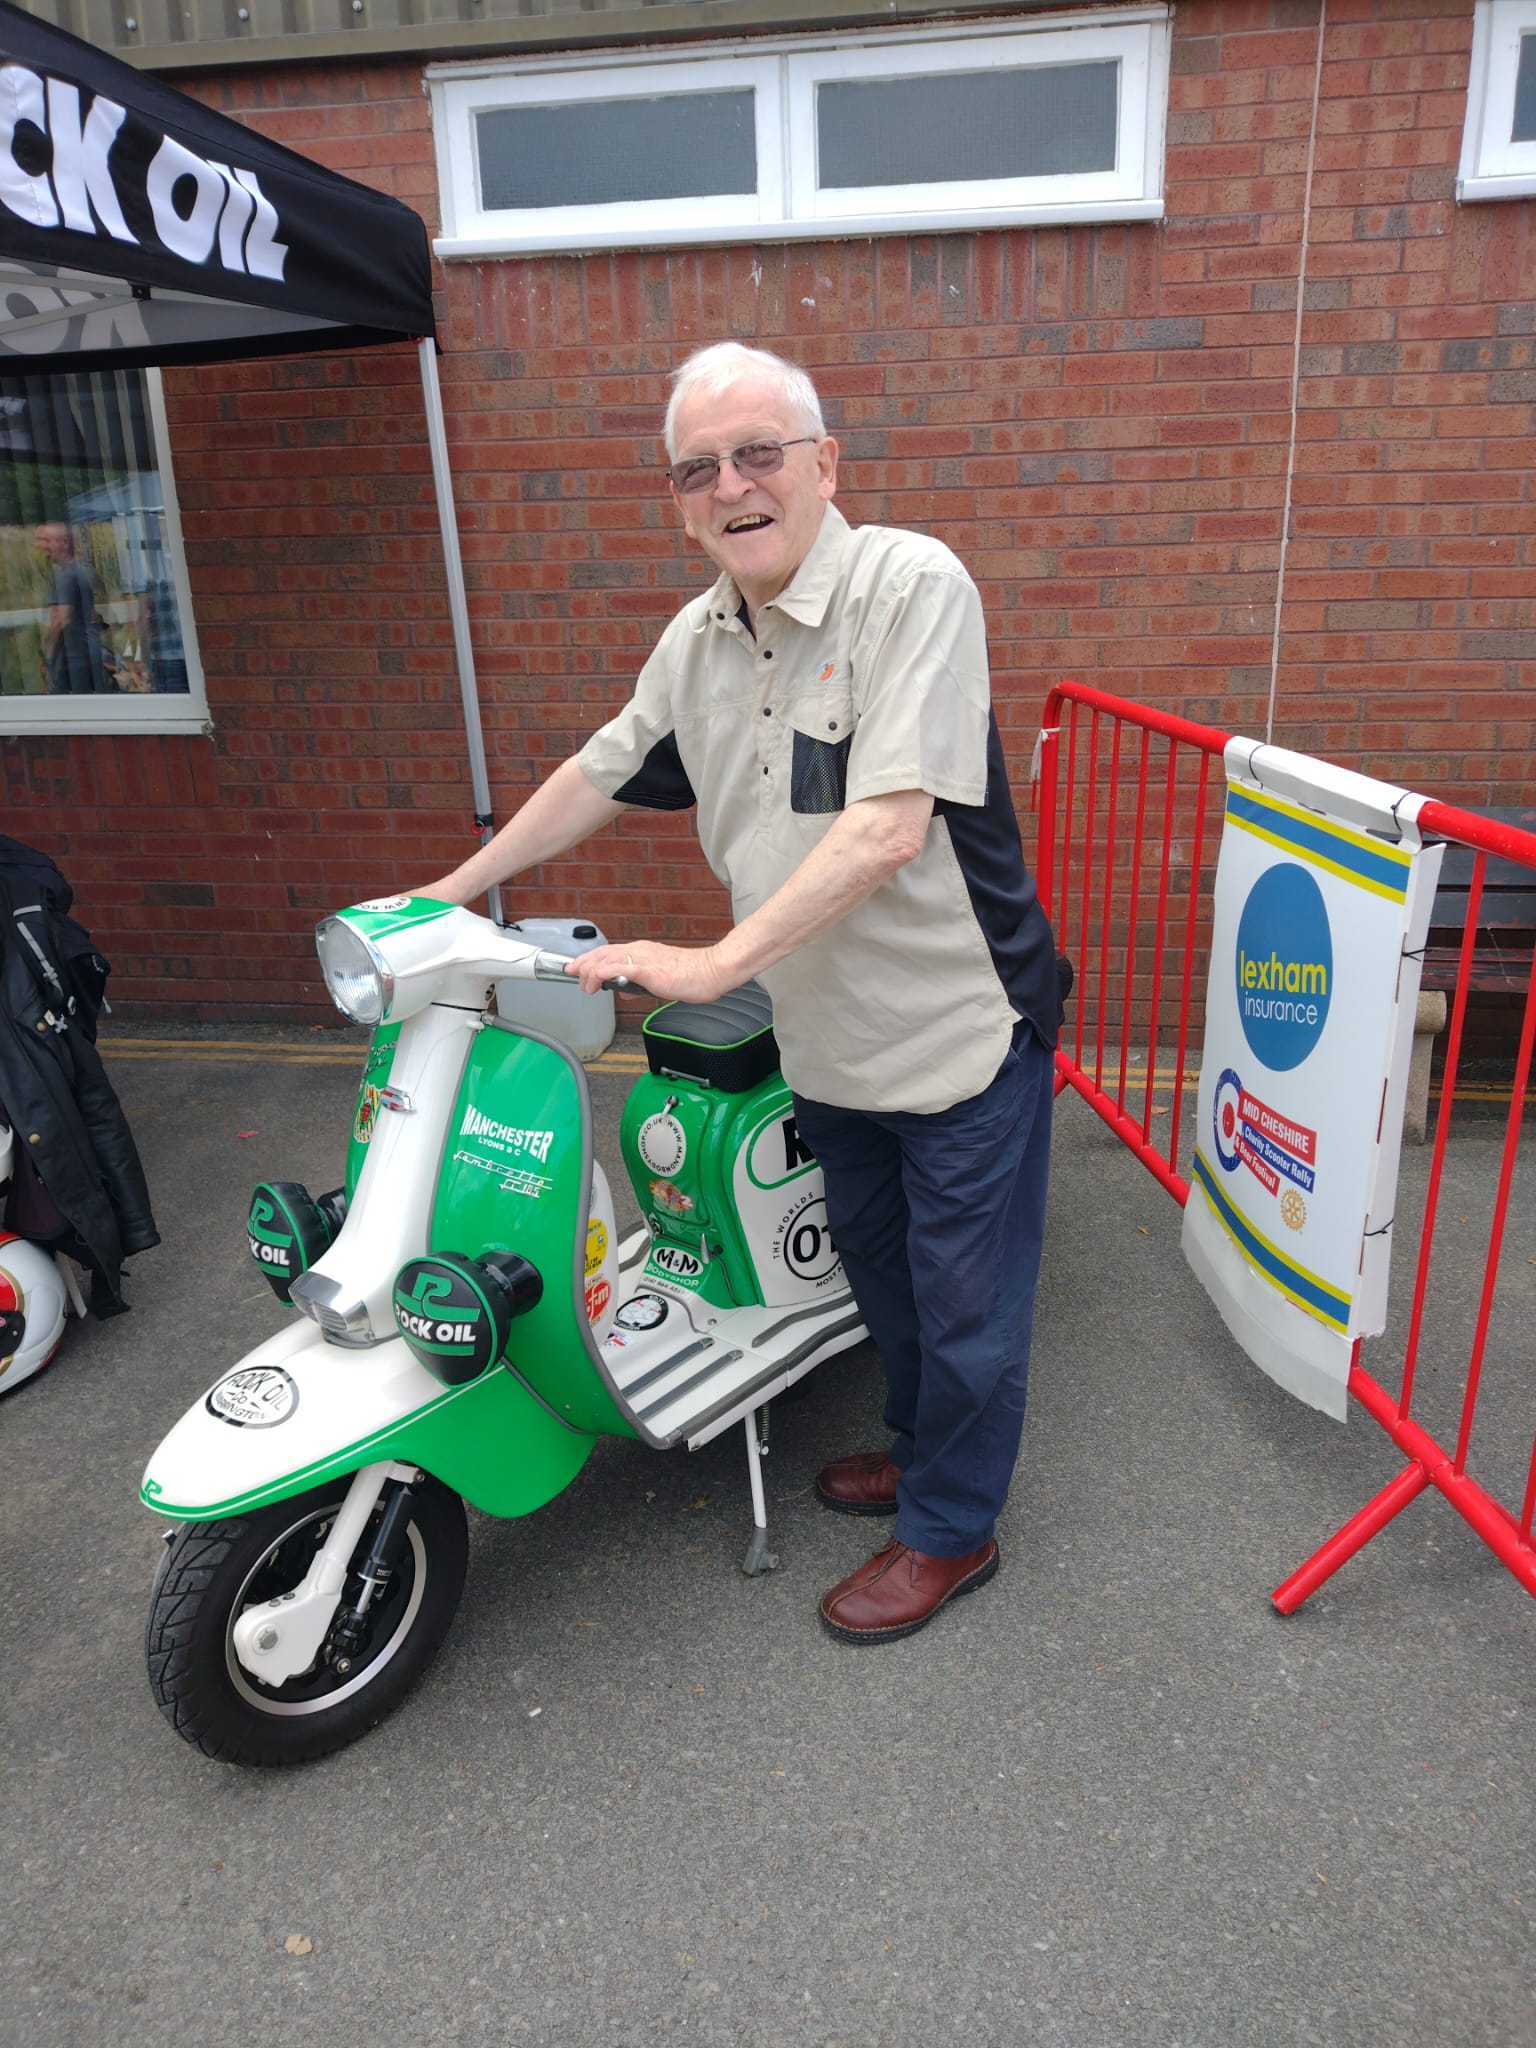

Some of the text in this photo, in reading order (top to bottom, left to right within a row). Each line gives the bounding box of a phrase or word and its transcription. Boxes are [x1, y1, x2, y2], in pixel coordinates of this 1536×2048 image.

[147, 134, 289, 283] OIL
[1240, 950, 1327, 995] lexham
[1245, 991, 1318, 1025] insurance
[460, 1104, 554, 1164] MANCHESTER
[1242, 1098, 1309, 1154] MID CHESHIRE
[478, 1137, 505, 1151] LYONS
[1244, 1125, 1313, 1189] Charity Scooter Rally
[1251, 1155, 1277, 1189] Festival
[776, 1192, 814, 1234] WORLDS
[261, 1245, 290, 1265] OIL
[656, 1248, 699, 1274] M&M
[646, 1262, 700, 1287] BODYSHOP
[815, 1271, 837, 1288] MOST
[436, 1323, 476, 1343] OIL
[261, 1383, 289, 1412] OIL
